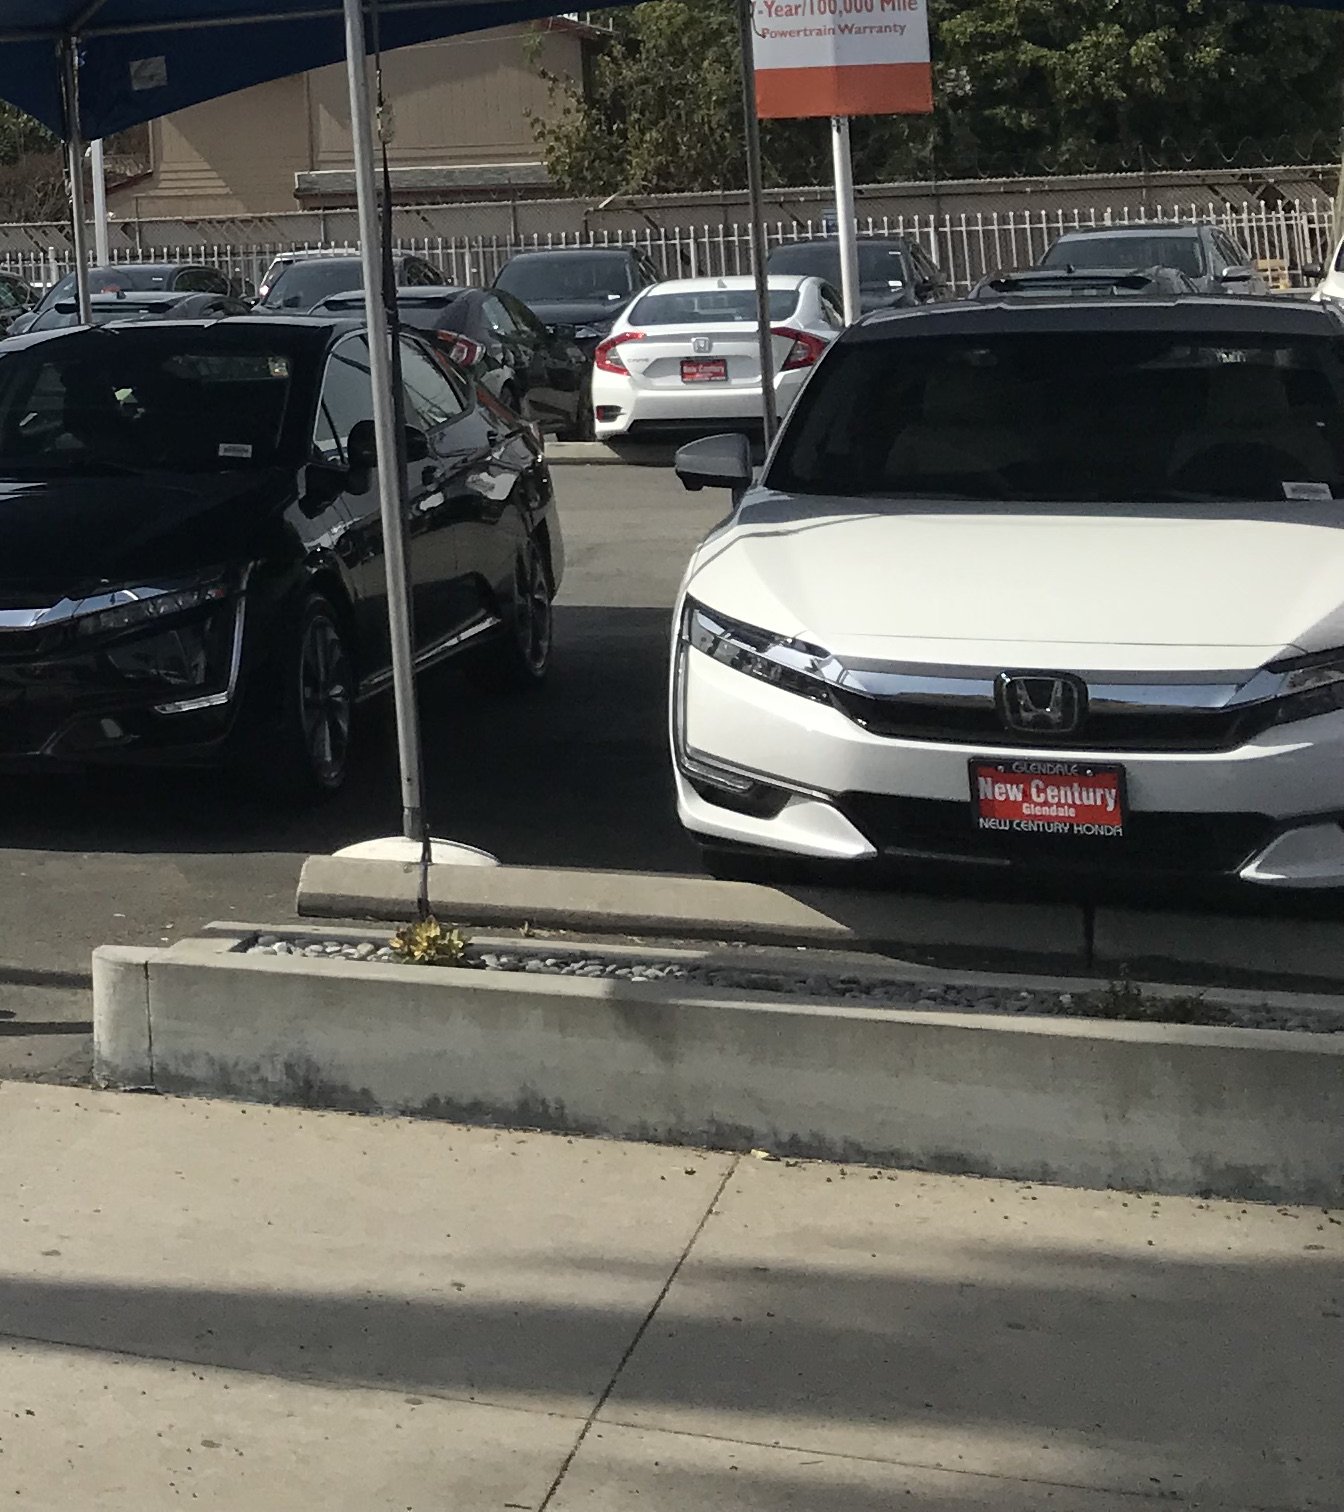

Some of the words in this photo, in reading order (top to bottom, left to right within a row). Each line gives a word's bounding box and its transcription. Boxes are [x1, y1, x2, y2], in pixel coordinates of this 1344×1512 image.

[763, 27, 836, 39] Powertrain
[837, 23, 907, 37] Warranty
[1013, 762, 1078, 775] GLENDALE
[978, 777, 1023, 801] New
[1031, 779, 1116, 811] Century
[1023, 803, 1076, 817] Glendale
[979, 818, 1010, 830] NEW
[1013, 820, 1070, 833] CENTURY
[1074, 823, 1122, 836] HONDA
